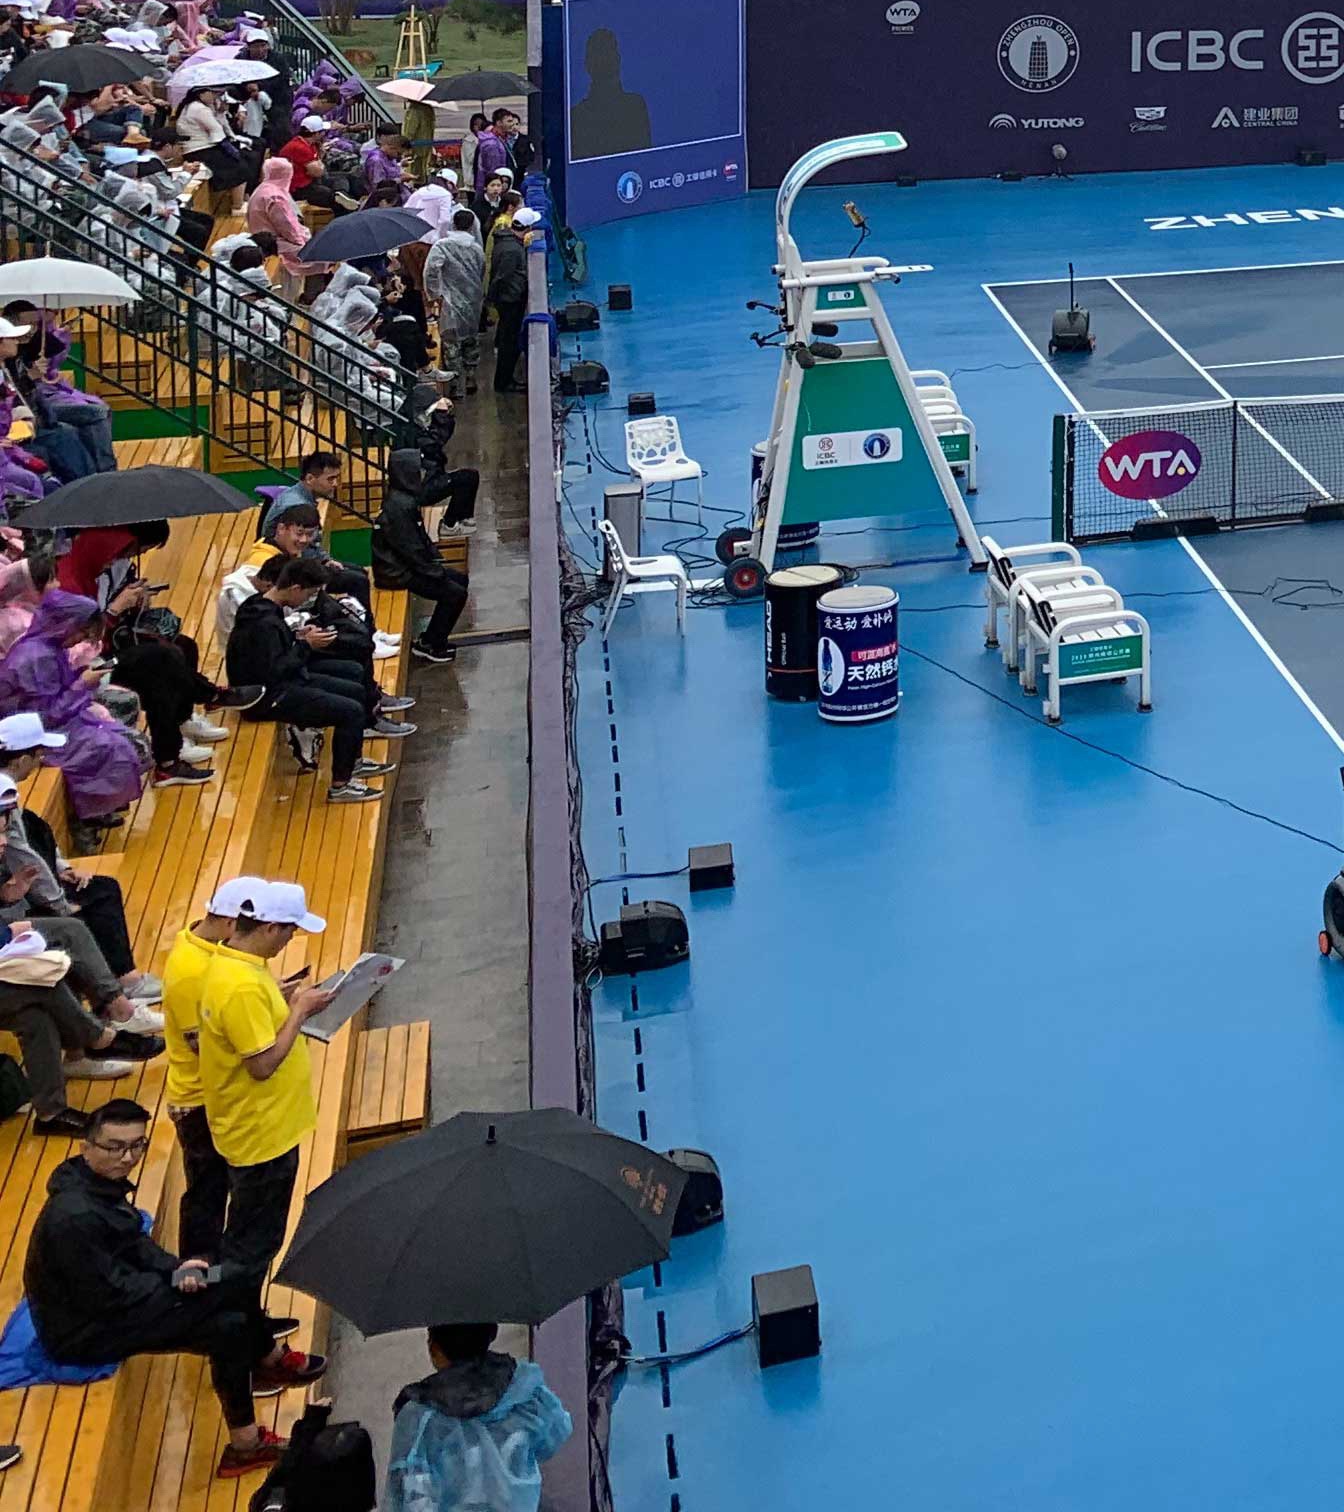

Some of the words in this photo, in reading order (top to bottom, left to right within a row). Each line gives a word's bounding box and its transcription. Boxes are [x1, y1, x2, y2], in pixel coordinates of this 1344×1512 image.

[890, 8, 917, 17] WTA
[1003, 18, 1054, 47] ZHENGZHOU
[1055, 24, 1074, 46] OPEN
[1131, 29, 1264, 72] ICBC
[1021, 117, 1085, 129] YUTONG
[649, 177, 671, 189] ICBC
[1104, 449, 1196, 482] WTA
